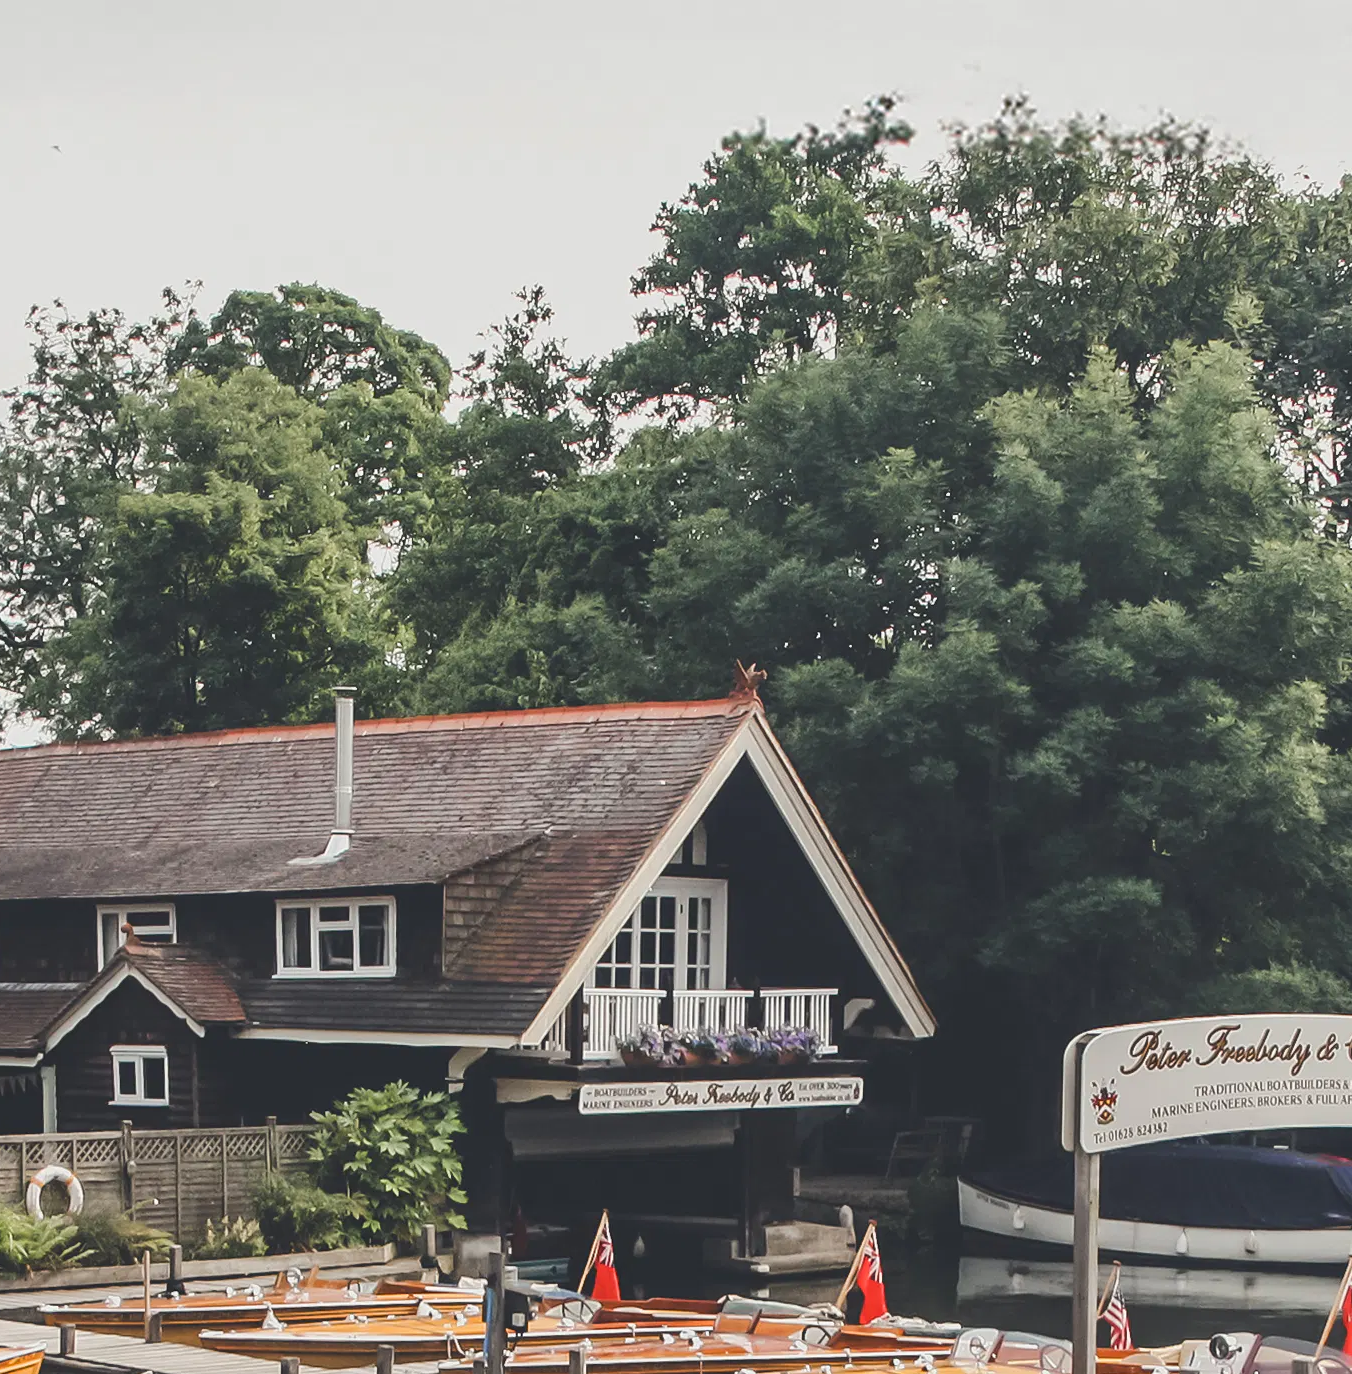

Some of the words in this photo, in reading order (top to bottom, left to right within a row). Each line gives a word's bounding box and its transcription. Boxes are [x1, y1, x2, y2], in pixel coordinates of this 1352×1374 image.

[1119, 1029, 1192, 1075] Peter
[1195, 1024, 1311, 1077] Freebody
[1316, 1033, 1340, 1062] &
[594, 1087, 647, 1098] BOATBUILDERS
[658, 1083, 698, 1106] Peter
[702, 1082, 761, 1108] Freebody
[763, 1086, 773, 1105] &
[1194, 1080, 1265, 1097] TRADITIONAL
[1267, 1079, 1341, 1091] BOATBUILDERS
[1342, 1080, 1349, 1090] &
[582, 1100, 611, 1110] MARINE
[614, 1099, 653, 1109] ENGINEERS
[1151, 1102, 1194, 1119] MARINE
[1258, 1095, 1302, 1107] BROKERS
[1306, 1095, 1314, 1105] &
[1315, 1094, 1339, 1105] FULL
[1093, 1133, 1107, 1144] Tel
[1108, 1127, 1134, 1142] 01628
